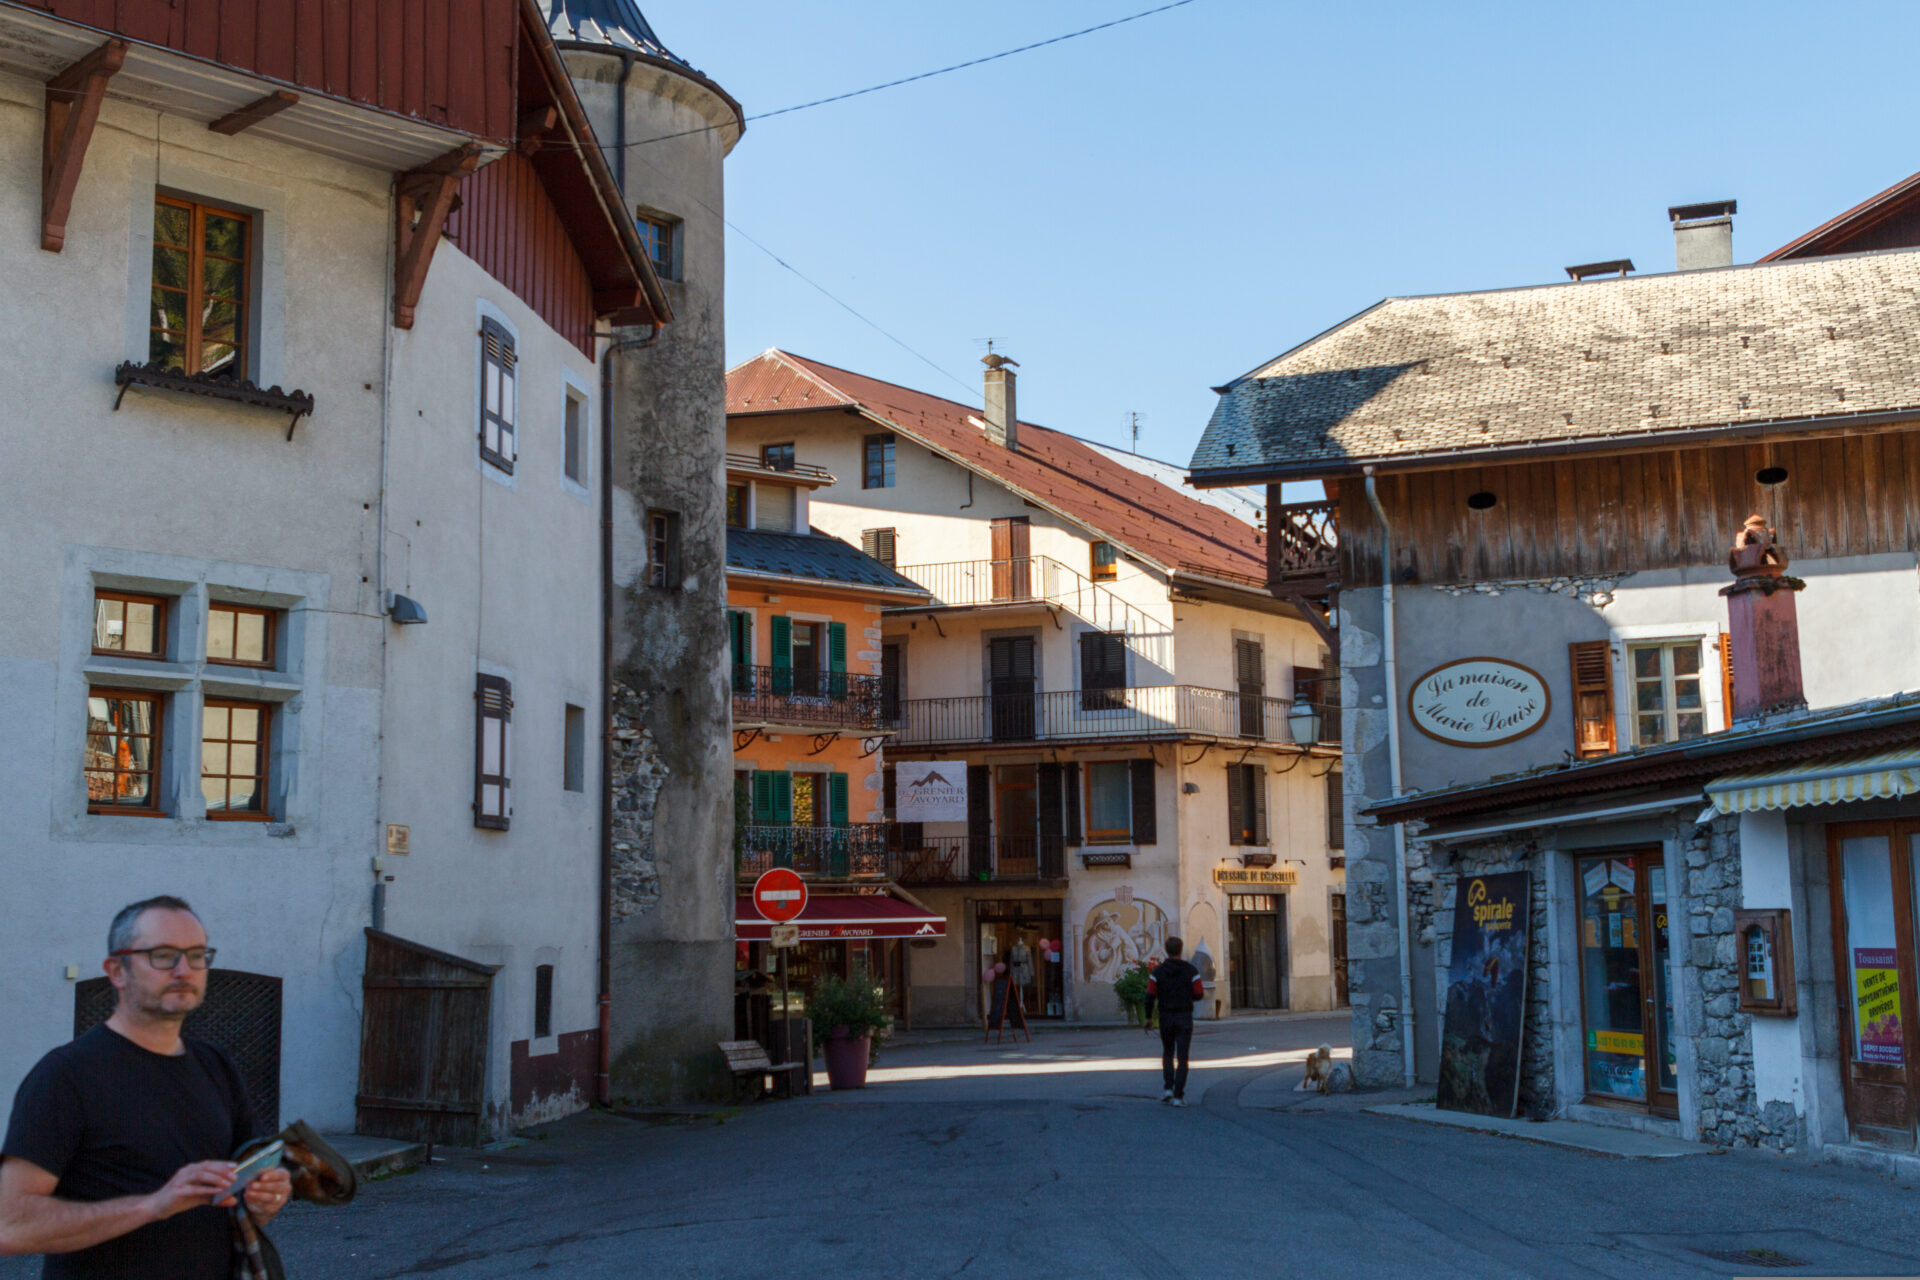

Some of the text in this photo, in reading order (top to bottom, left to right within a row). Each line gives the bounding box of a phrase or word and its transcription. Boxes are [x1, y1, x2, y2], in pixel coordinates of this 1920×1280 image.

[1427, 671, 1528, 700] La maison
[1465, 690, 1490, 708] de
[1418, 698, 1537, 732] Marie Louise
[914, 787, 964, 795] GRENIER
[1473, 896, 1513, 927] spirale
[799, 929, 830, 937] GRENIER
[1857, 951, 1894, 965] Toussaint
[1863, 971, 1886, 989] VENTE DE
